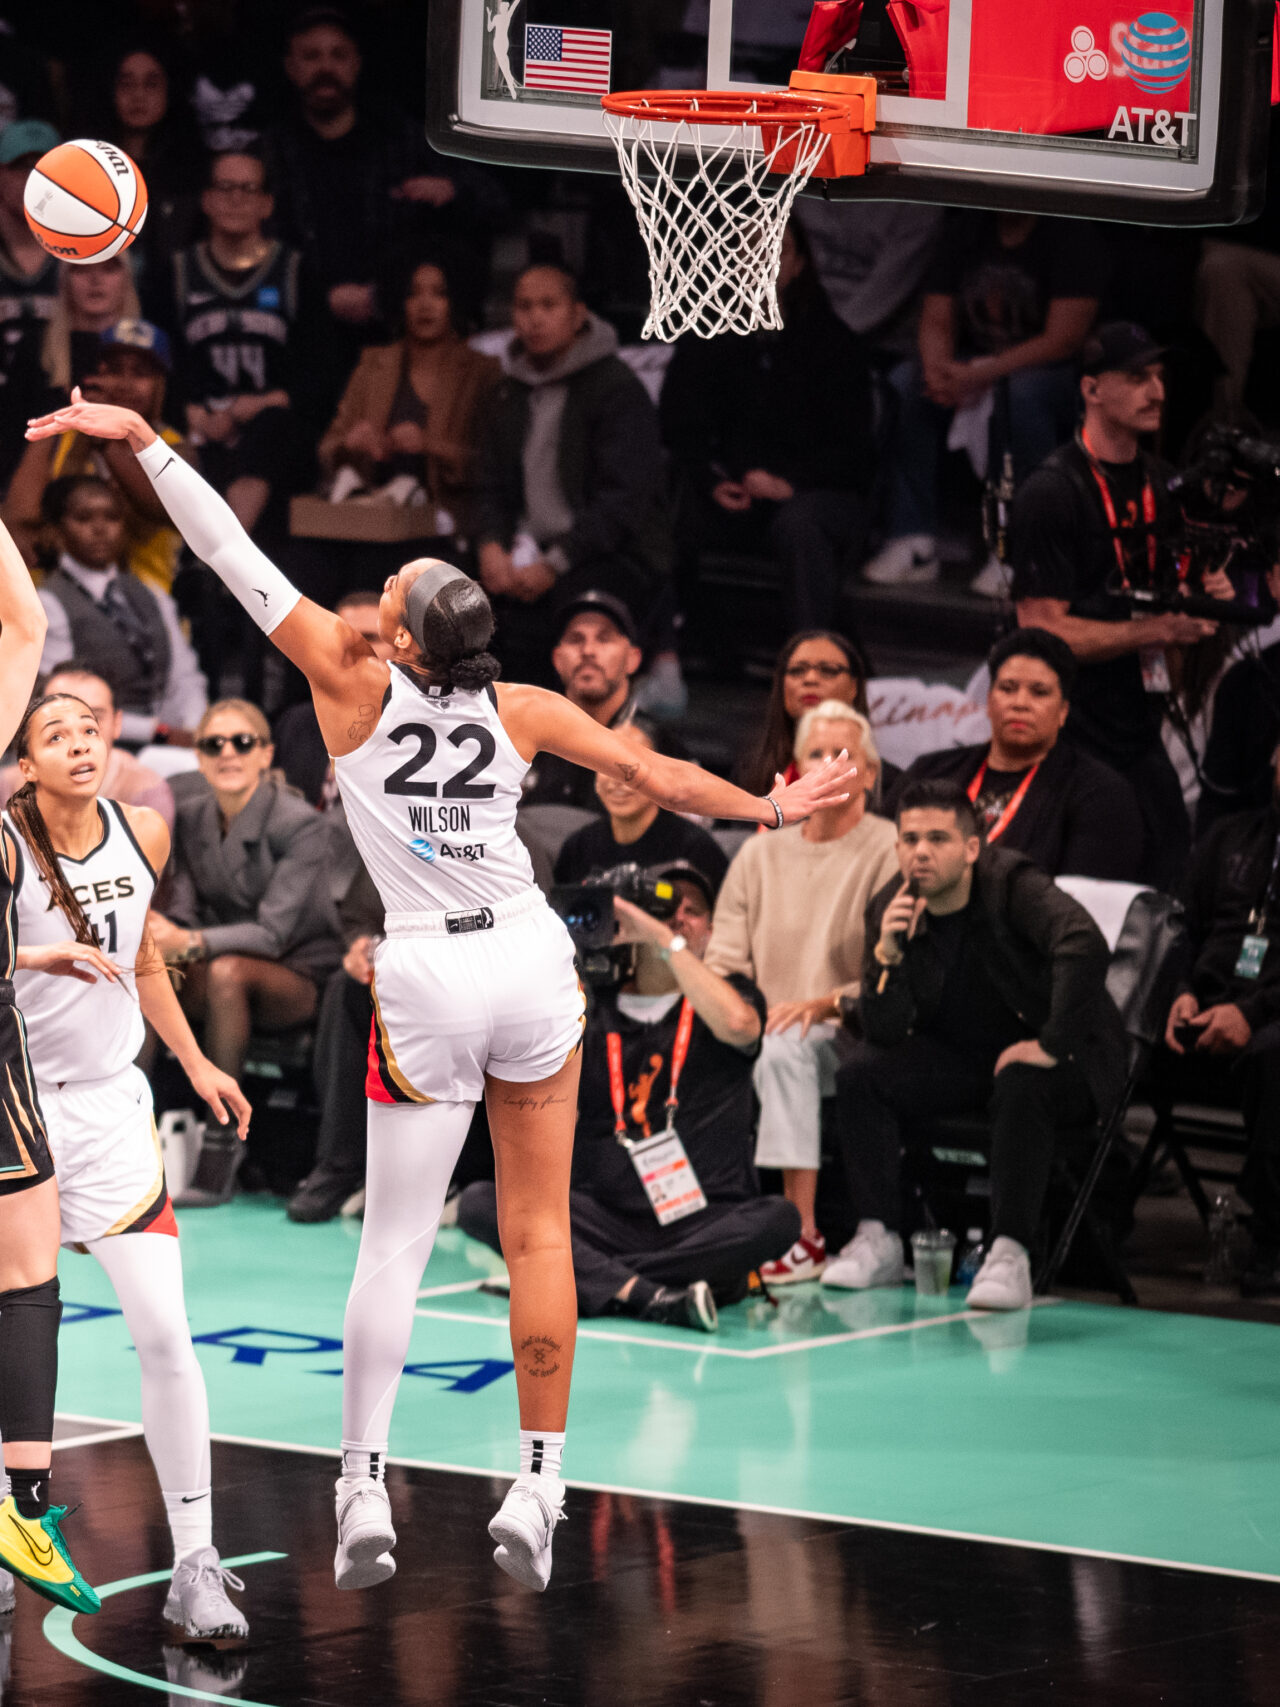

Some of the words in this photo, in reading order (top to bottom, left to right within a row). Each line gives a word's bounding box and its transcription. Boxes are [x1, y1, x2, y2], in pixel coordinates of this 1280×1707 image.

[1108, 106, 1197, 147] AT&T
[384, 722, 497, 799] 22
[408, 805, 471, 833] WILSON
[439, 843, 487, 862] AT&T
